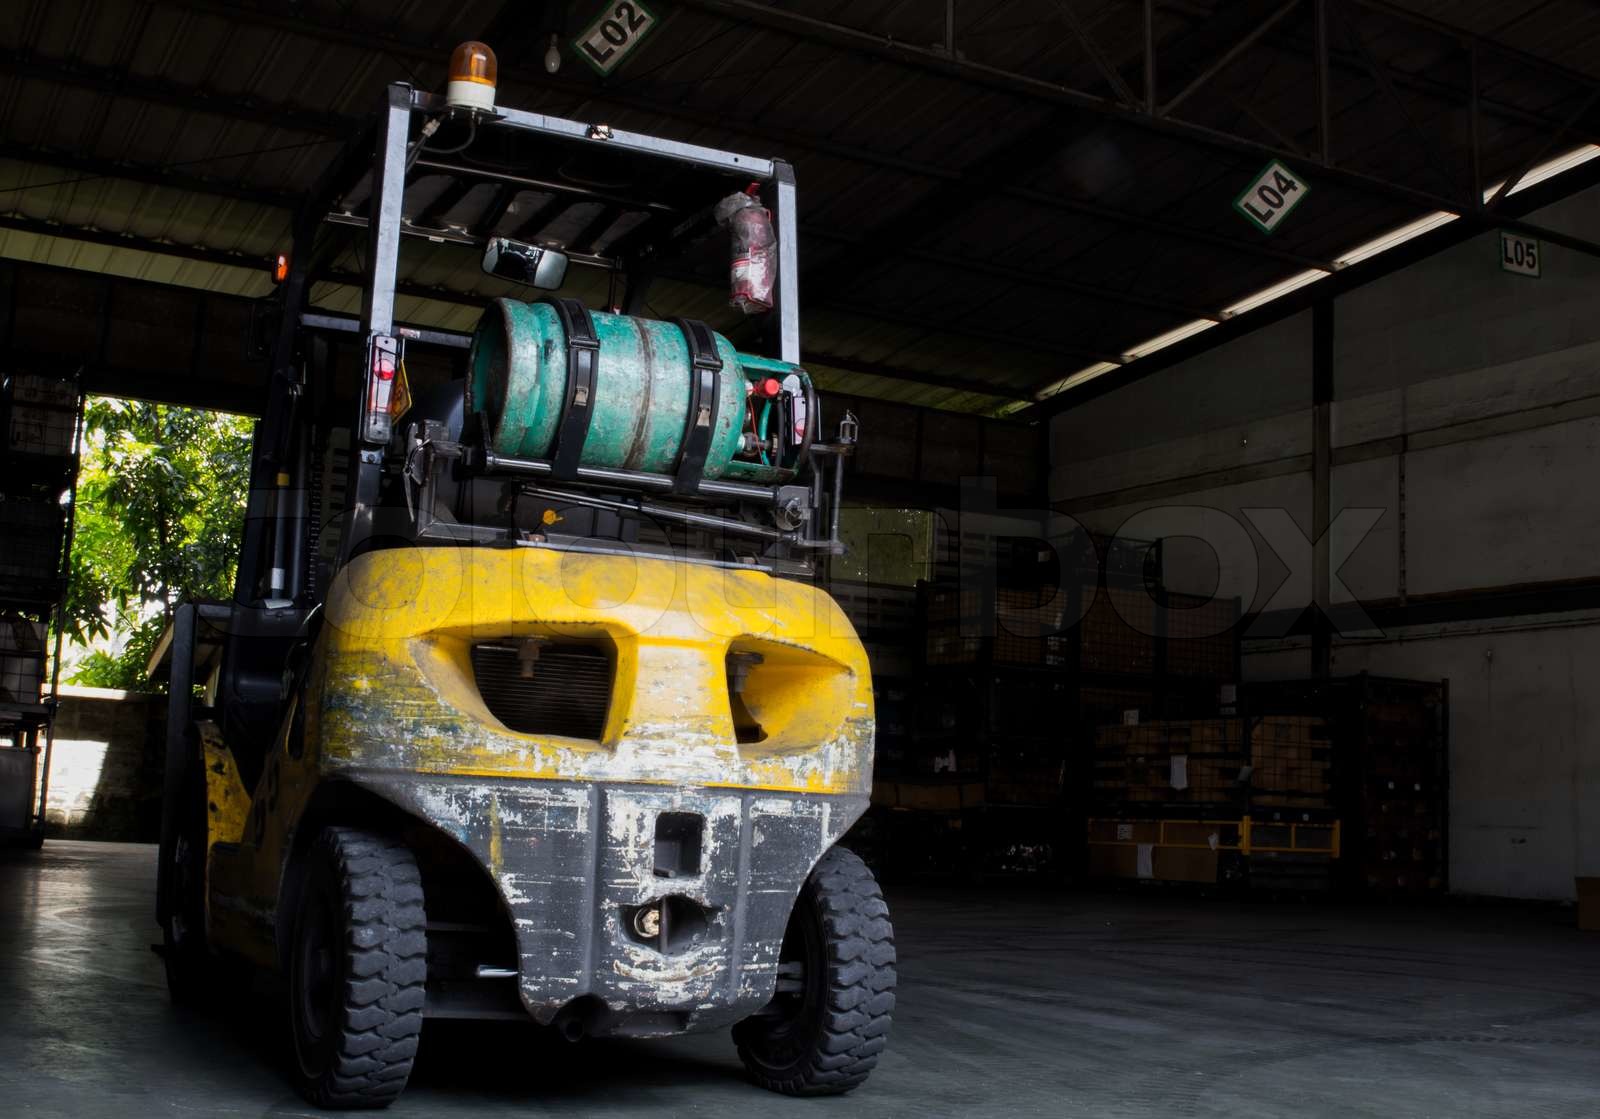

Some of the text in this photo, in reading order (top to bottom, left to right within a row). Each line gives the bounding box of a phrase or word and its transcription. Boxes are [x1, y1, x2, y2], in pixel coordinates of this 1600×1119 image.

[582, 2, 646, 63] L02
[1244, 171, 1298, 224] L04
[1503, 237, 1537, 269] L05
